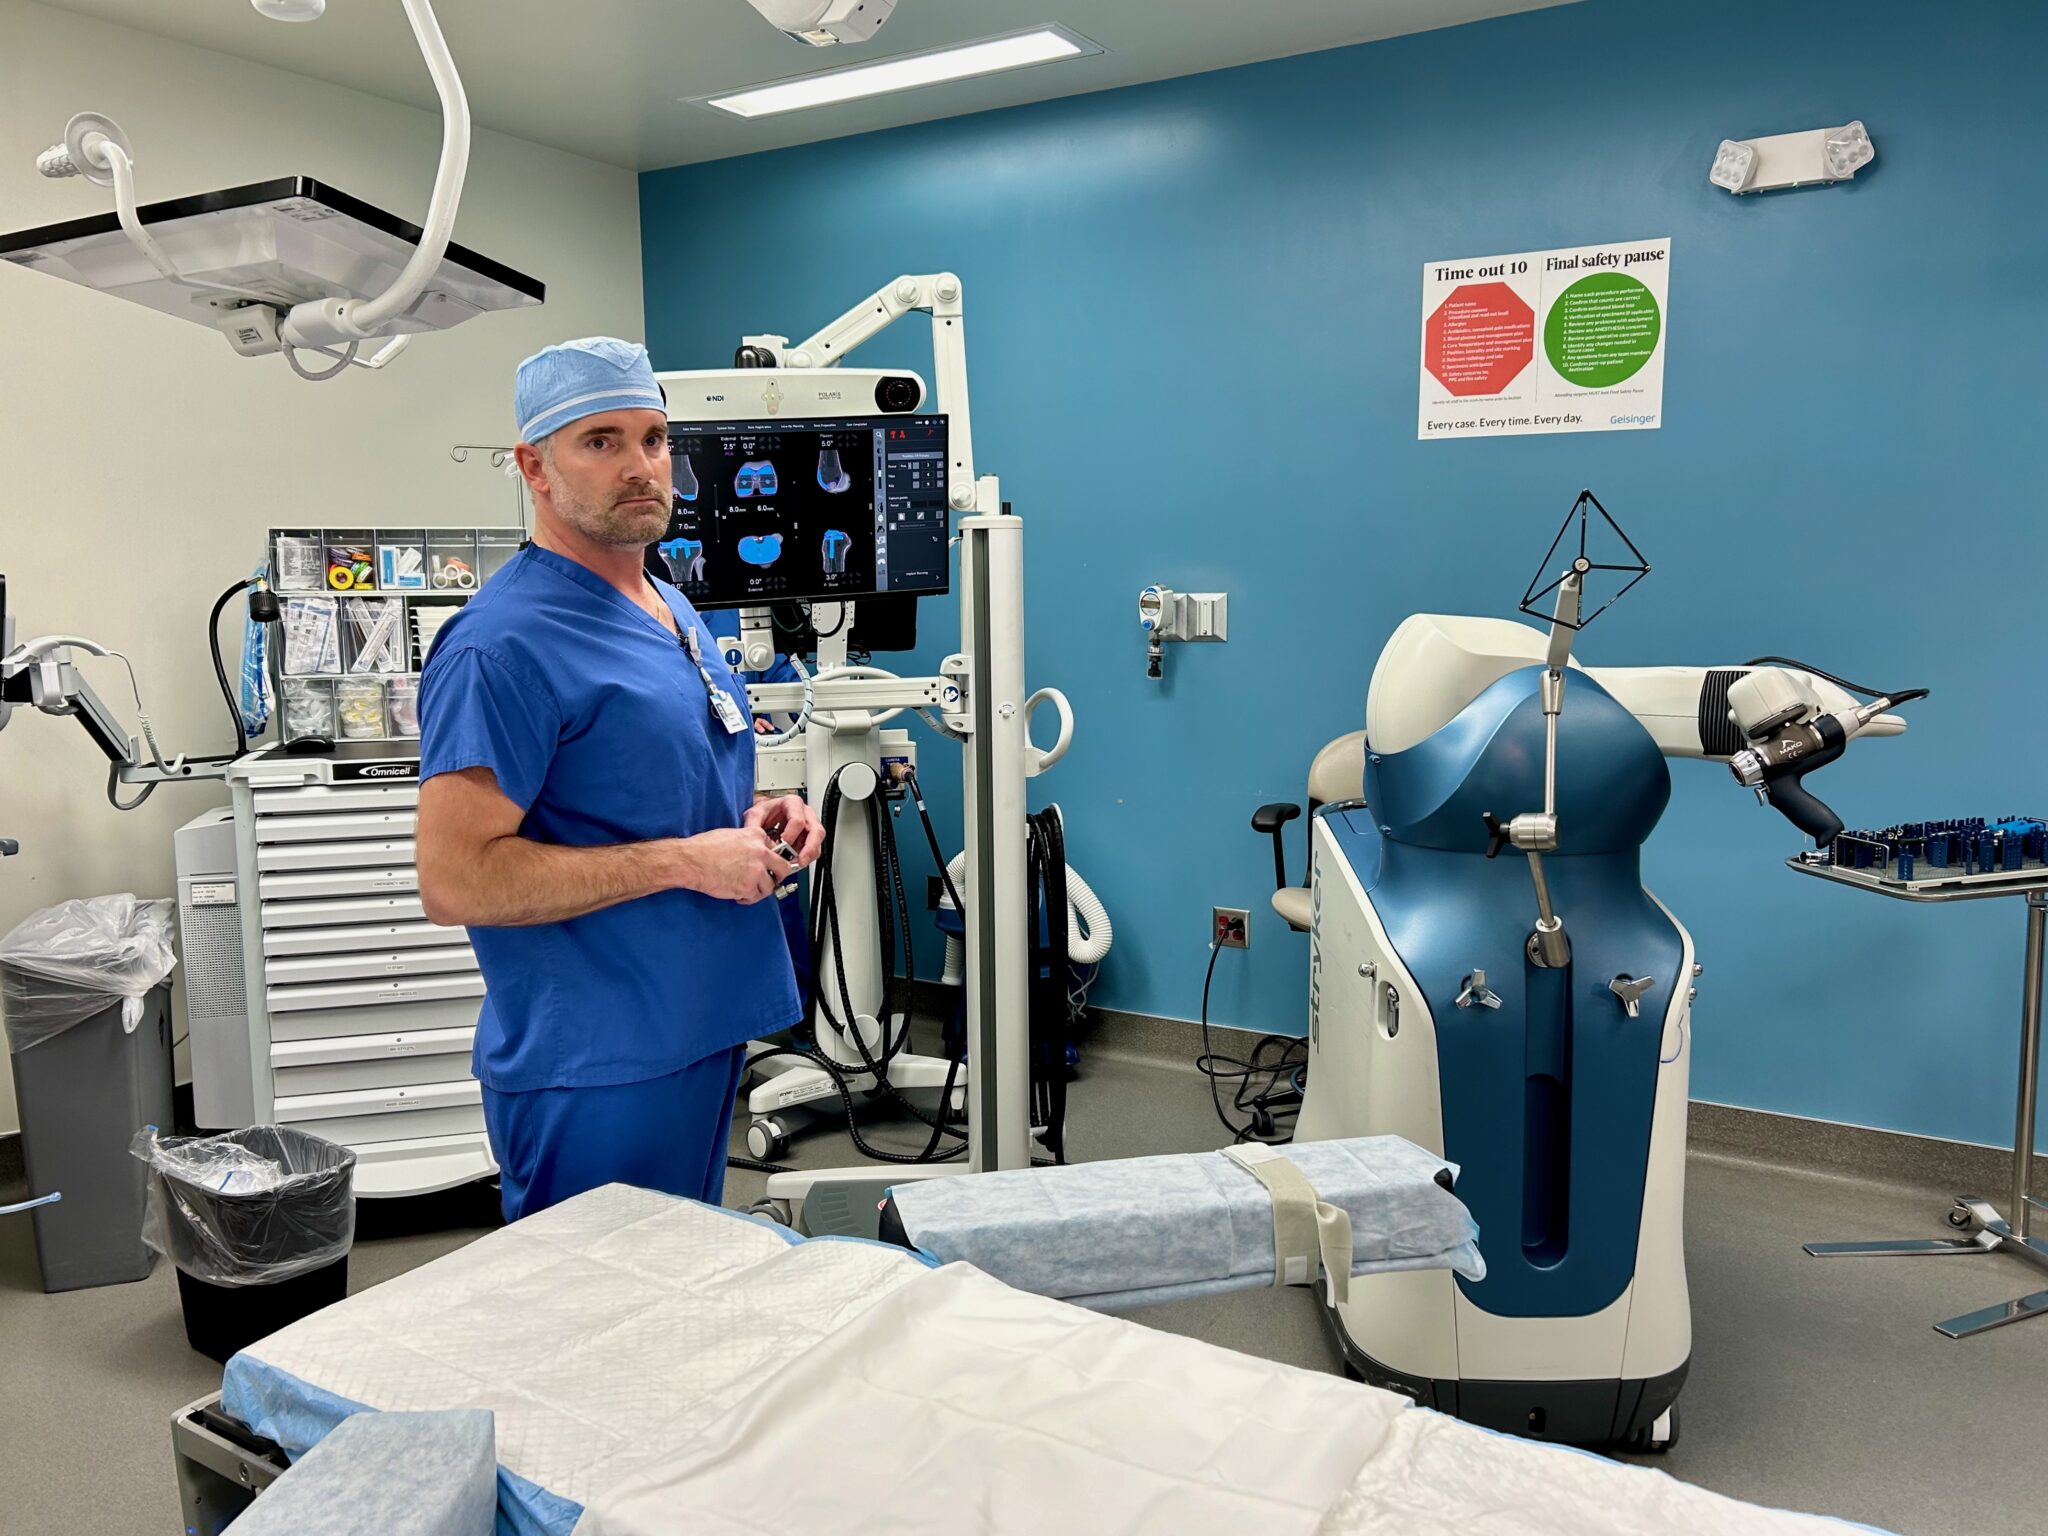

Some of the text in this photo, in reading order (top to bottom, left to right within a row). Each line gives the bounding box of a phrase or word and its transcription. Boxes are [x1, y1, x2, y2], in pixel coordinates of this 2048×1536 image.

[1546, 249, 1664, 271] Final safety pause
[1434, 261, 1528, 282] Time out 10
[1427, 414, 1582, 430] Every case. Every time. Every day.
[1610, 414, 1655, 425] Geisinger
[1779, 741, 1803, 754] MAKO
[371, 767, 410, 776] Omnicell
[1311, 850, 1321, 1054] stryker
